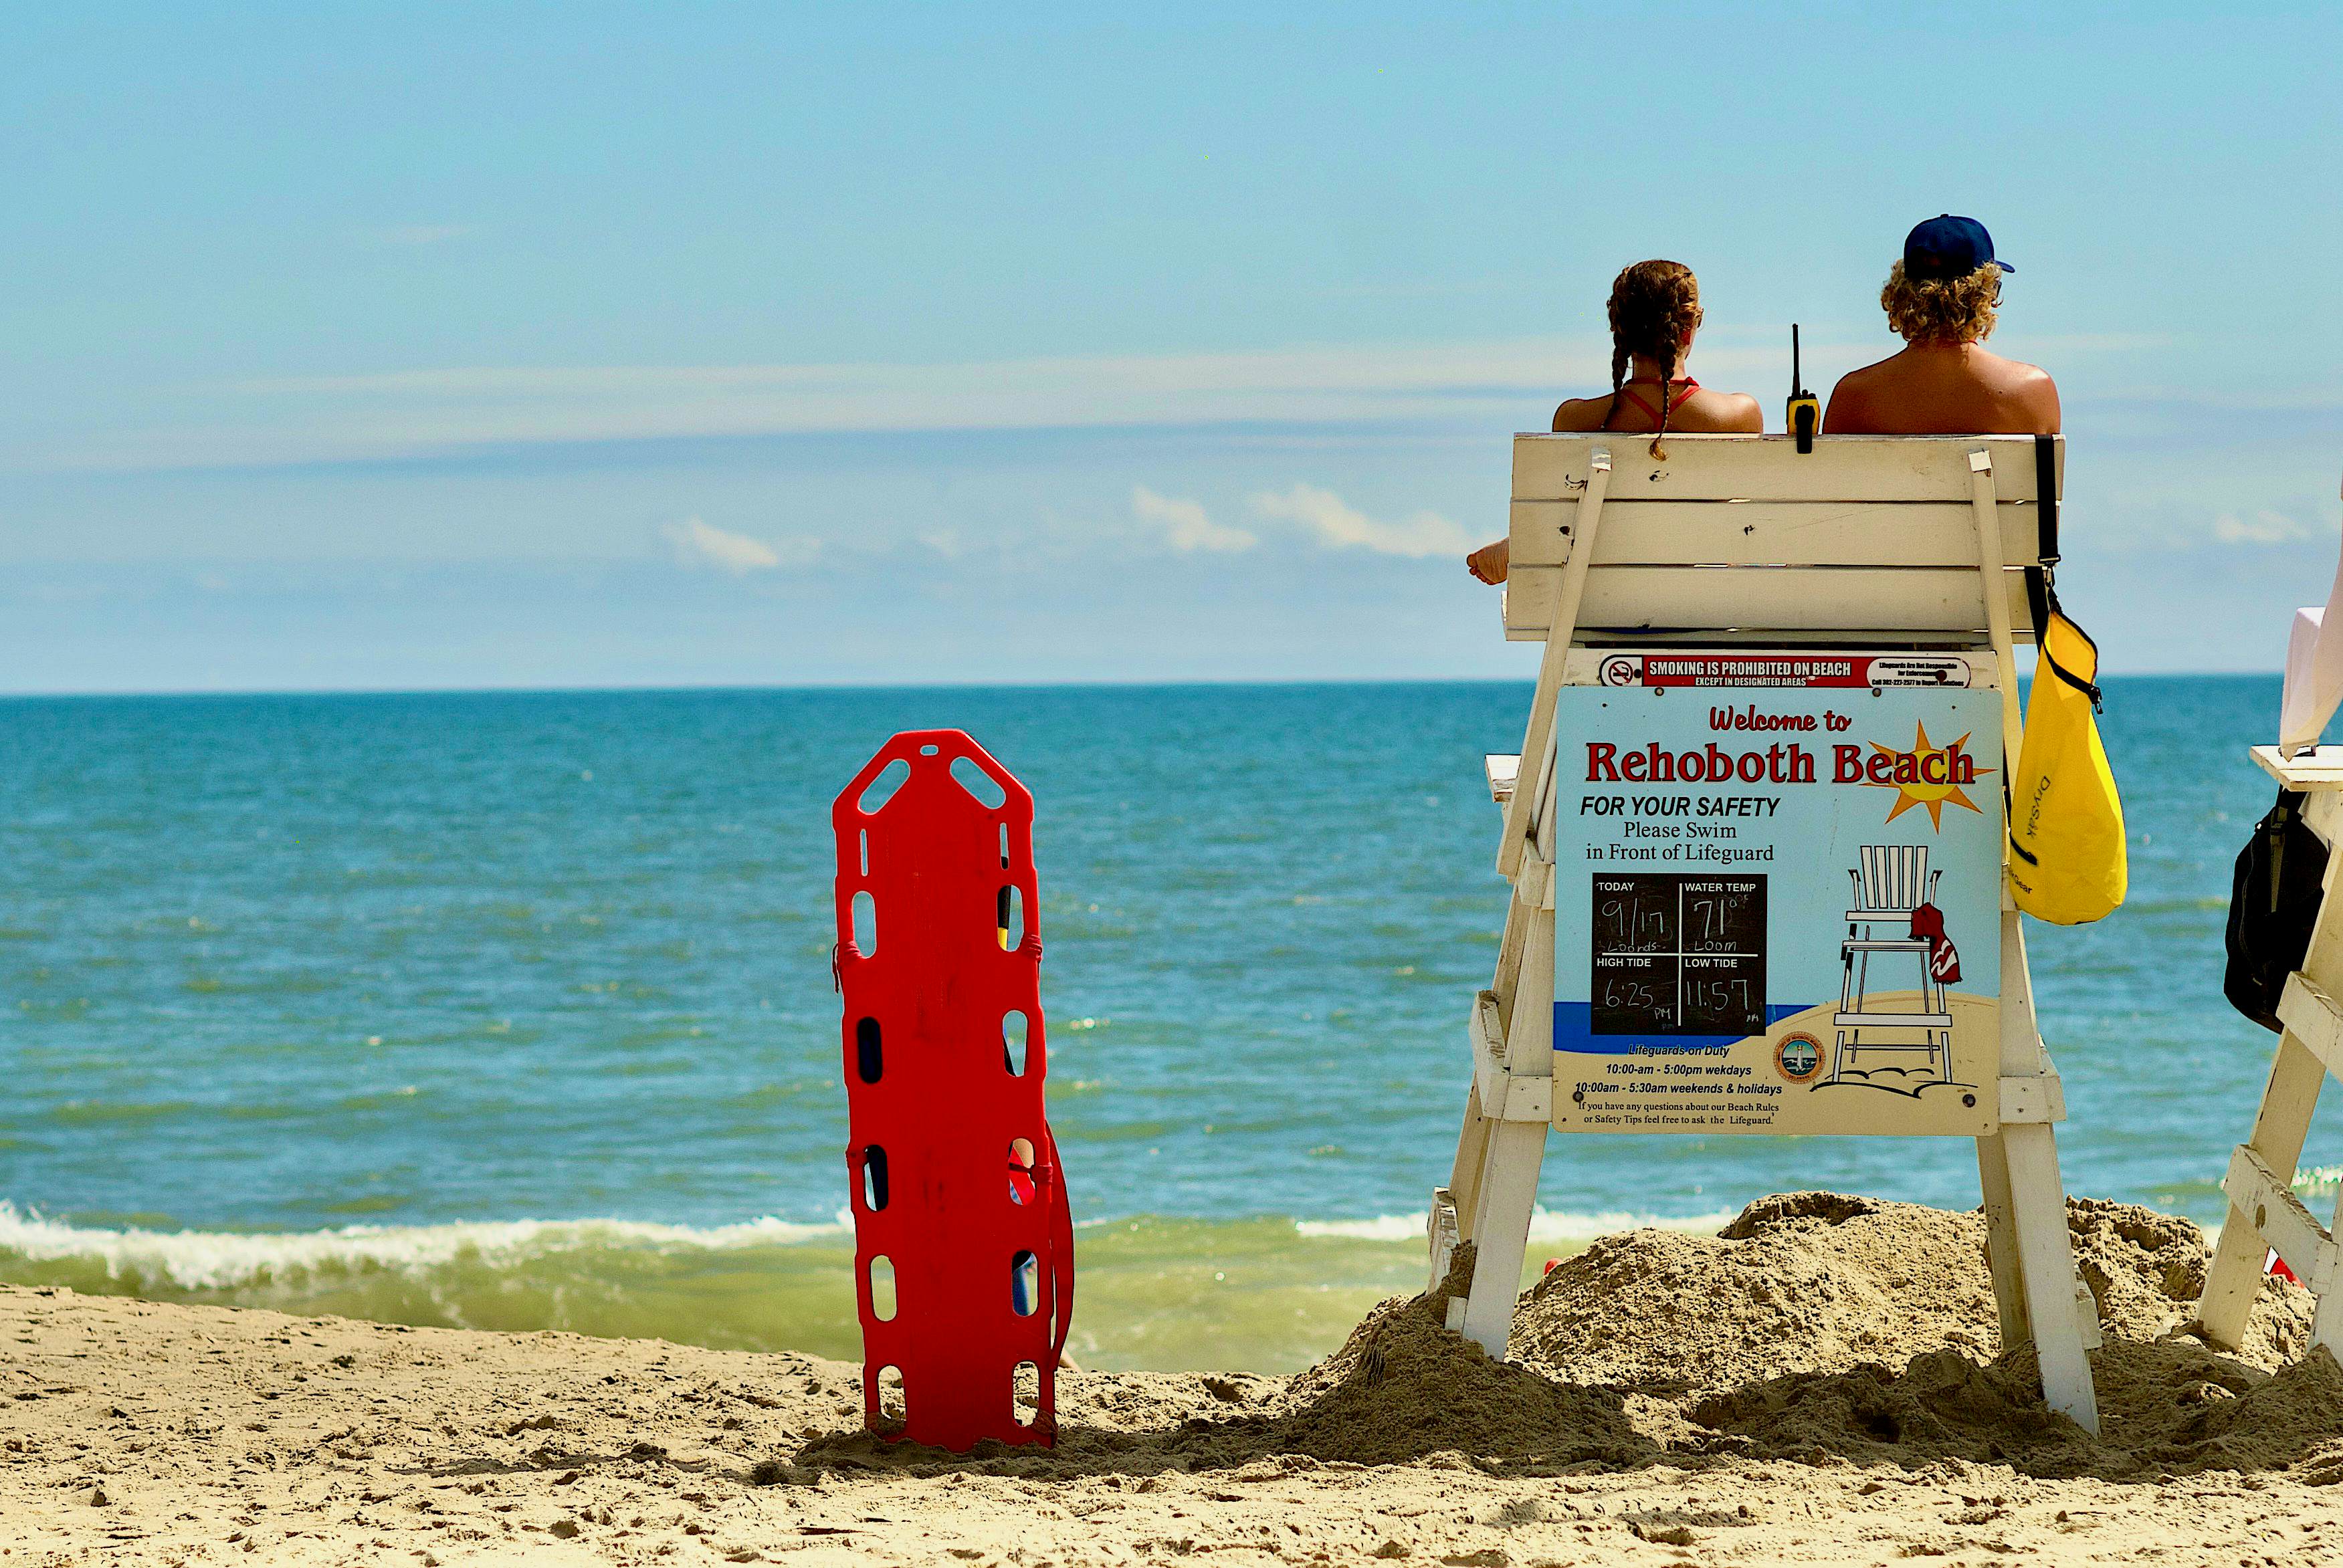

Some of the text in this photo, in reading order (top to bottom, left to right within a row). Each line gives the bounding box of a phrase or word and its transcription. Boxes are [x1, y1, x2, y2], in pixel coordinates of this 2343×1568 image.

[1649, 661, 1851, 677] SMOKING IS PROHIBITED ON BEACH
[1695, 677, 1807, 687] EXCEPT IN DESIGNATED AREAS
[1710, 704, 1852, 732] Welcome to
[1585, 742, 1976, 785] Rehoboth Beach
[1580, 796, 1781, 817] FOR YOUR SAFETY
[1623, 821, 1737, 838] Please Swim
[1586, 843, 1774, 865] in Front of Lifeguard
[1598, 882, 1635, 891] TODAY
[1685, 883, 1756, 892] WATER TEMP
[1597, 958, 1651, 967] HIGH TIDE
[1685, 959, 1738, 968] LOW TIDE
[1605, 979, 1671, 1020] 6:25 PM
[1628, 1044, 1730, 1058] Lifeguards on Duty
[1606, 1063, 1654, 1075] 10:00-am
[1663, 1065, 1702, 1077] 5:00pm
[1706, 1065, 1752, 1078] wekdays
[1575, 1082, 1619, 1093] 10:00am
[1629, 1083, 1667, 1093] 5:30am
[1670, 1083, 1724, 1094] weekends
[1726, 1083, 1734, 1094] &
[1737, 1083, 1782, 1097] holidays
[1578, 1101, 1587, 1110] If
[1587, 1104, 1603, 1112] you
[1605, 1102, 1625, 1111] have
[1626, 1104, 1642, 1113] any
[1643, 1102, 1684, 1113] questions
[1685, 1103, 1710, 1111] about
[1728, 1103, 1754, 1111] Beach
[1756, 1103, 1779, 1111] Rules
[1595, 1115, 1622, 1125] Safety
[1623, 1115, 1643, 1125] Tips
[1644, 1115, 1659, 1124] feel
[1662, 1115, 1679, 1124] free
[1681, 1116, 1690, 1124] to
[1692, 1116, 1706, 1124] ask
[1710, 1116, 1725, 1124] the
[1730, 1116, 1774, 1126] Lifeguard.
